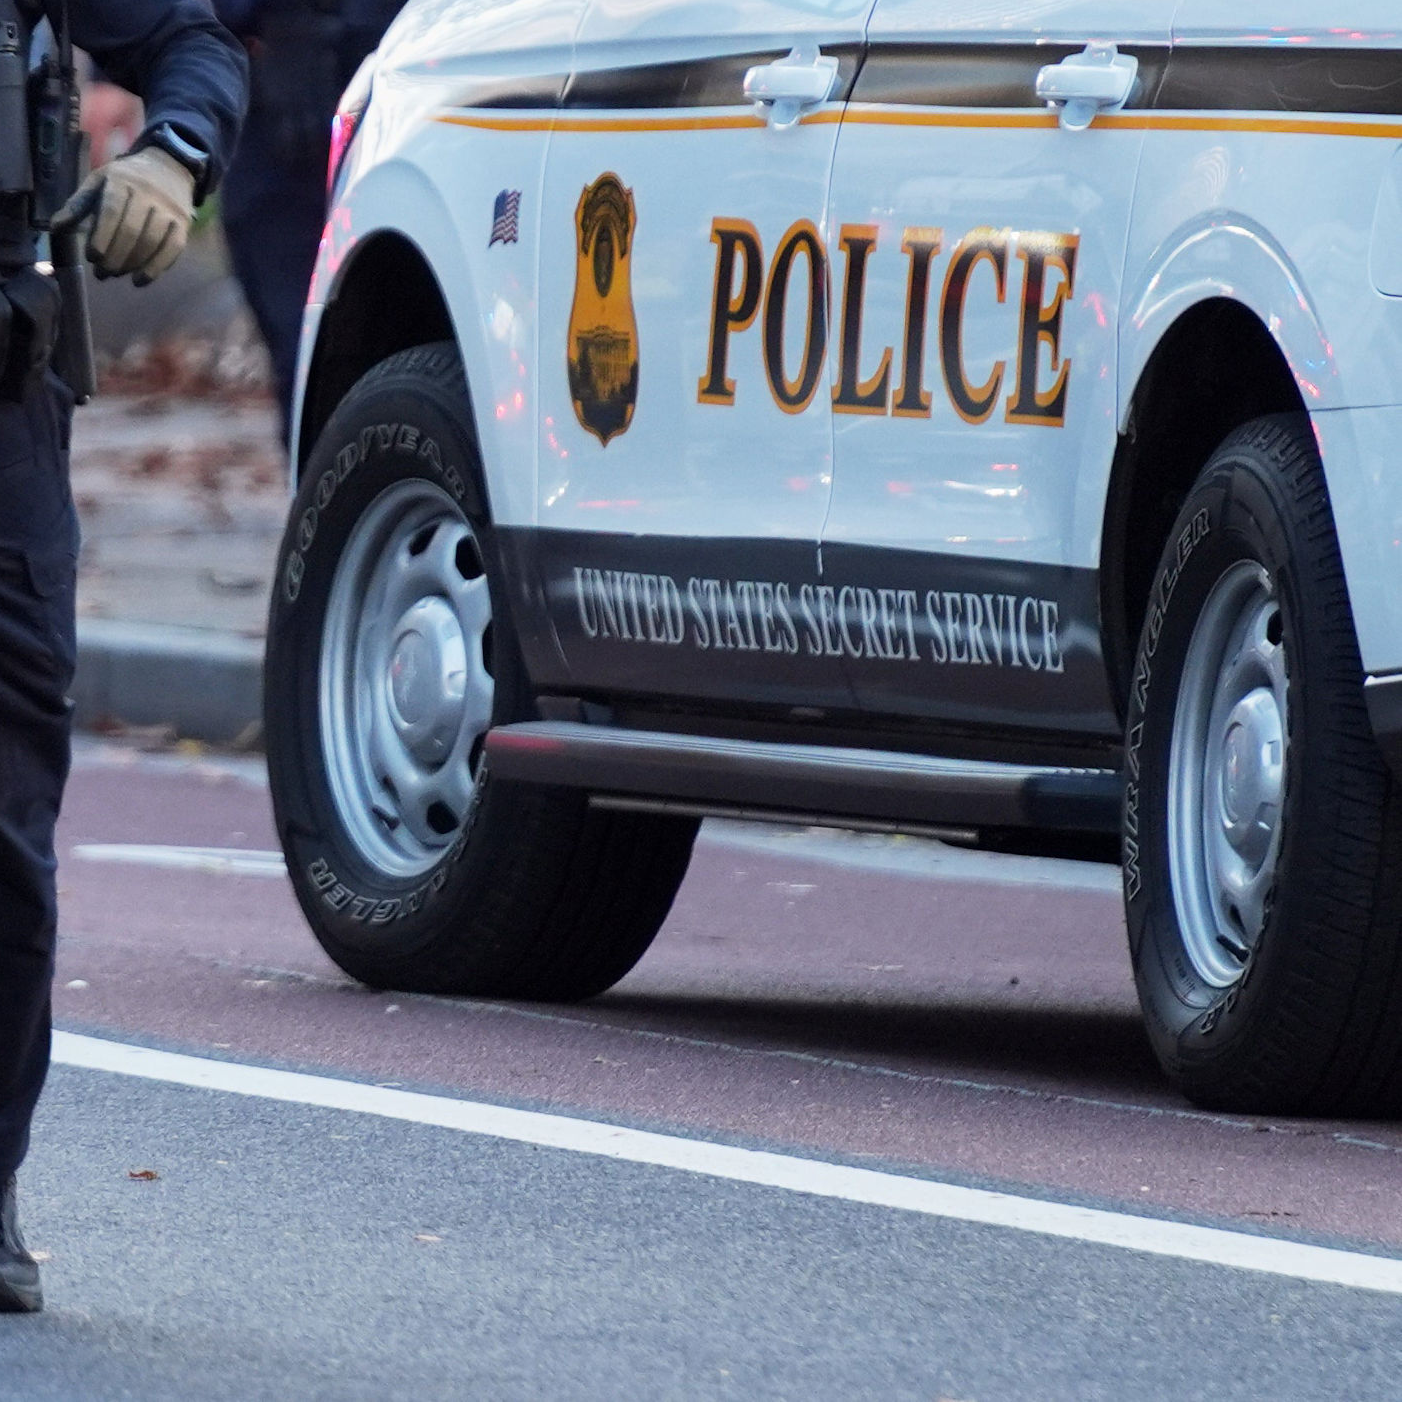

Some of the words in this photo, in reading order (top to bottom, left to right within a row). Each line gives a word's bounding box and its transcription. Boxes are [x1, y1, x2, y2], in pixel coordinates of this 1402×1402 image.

[697, 216, 1080, 428] POLICE
[283, 423, 466, 602] GOODYEAR
[573, 566, 685, 645] UNITED
[685, 576, 798, 655] STATES
[800, 583, 922, 661] SECRET
[926, 590, 1065, 674] SERVICE
[1125, 506, 1211, 902] WRANGLER
